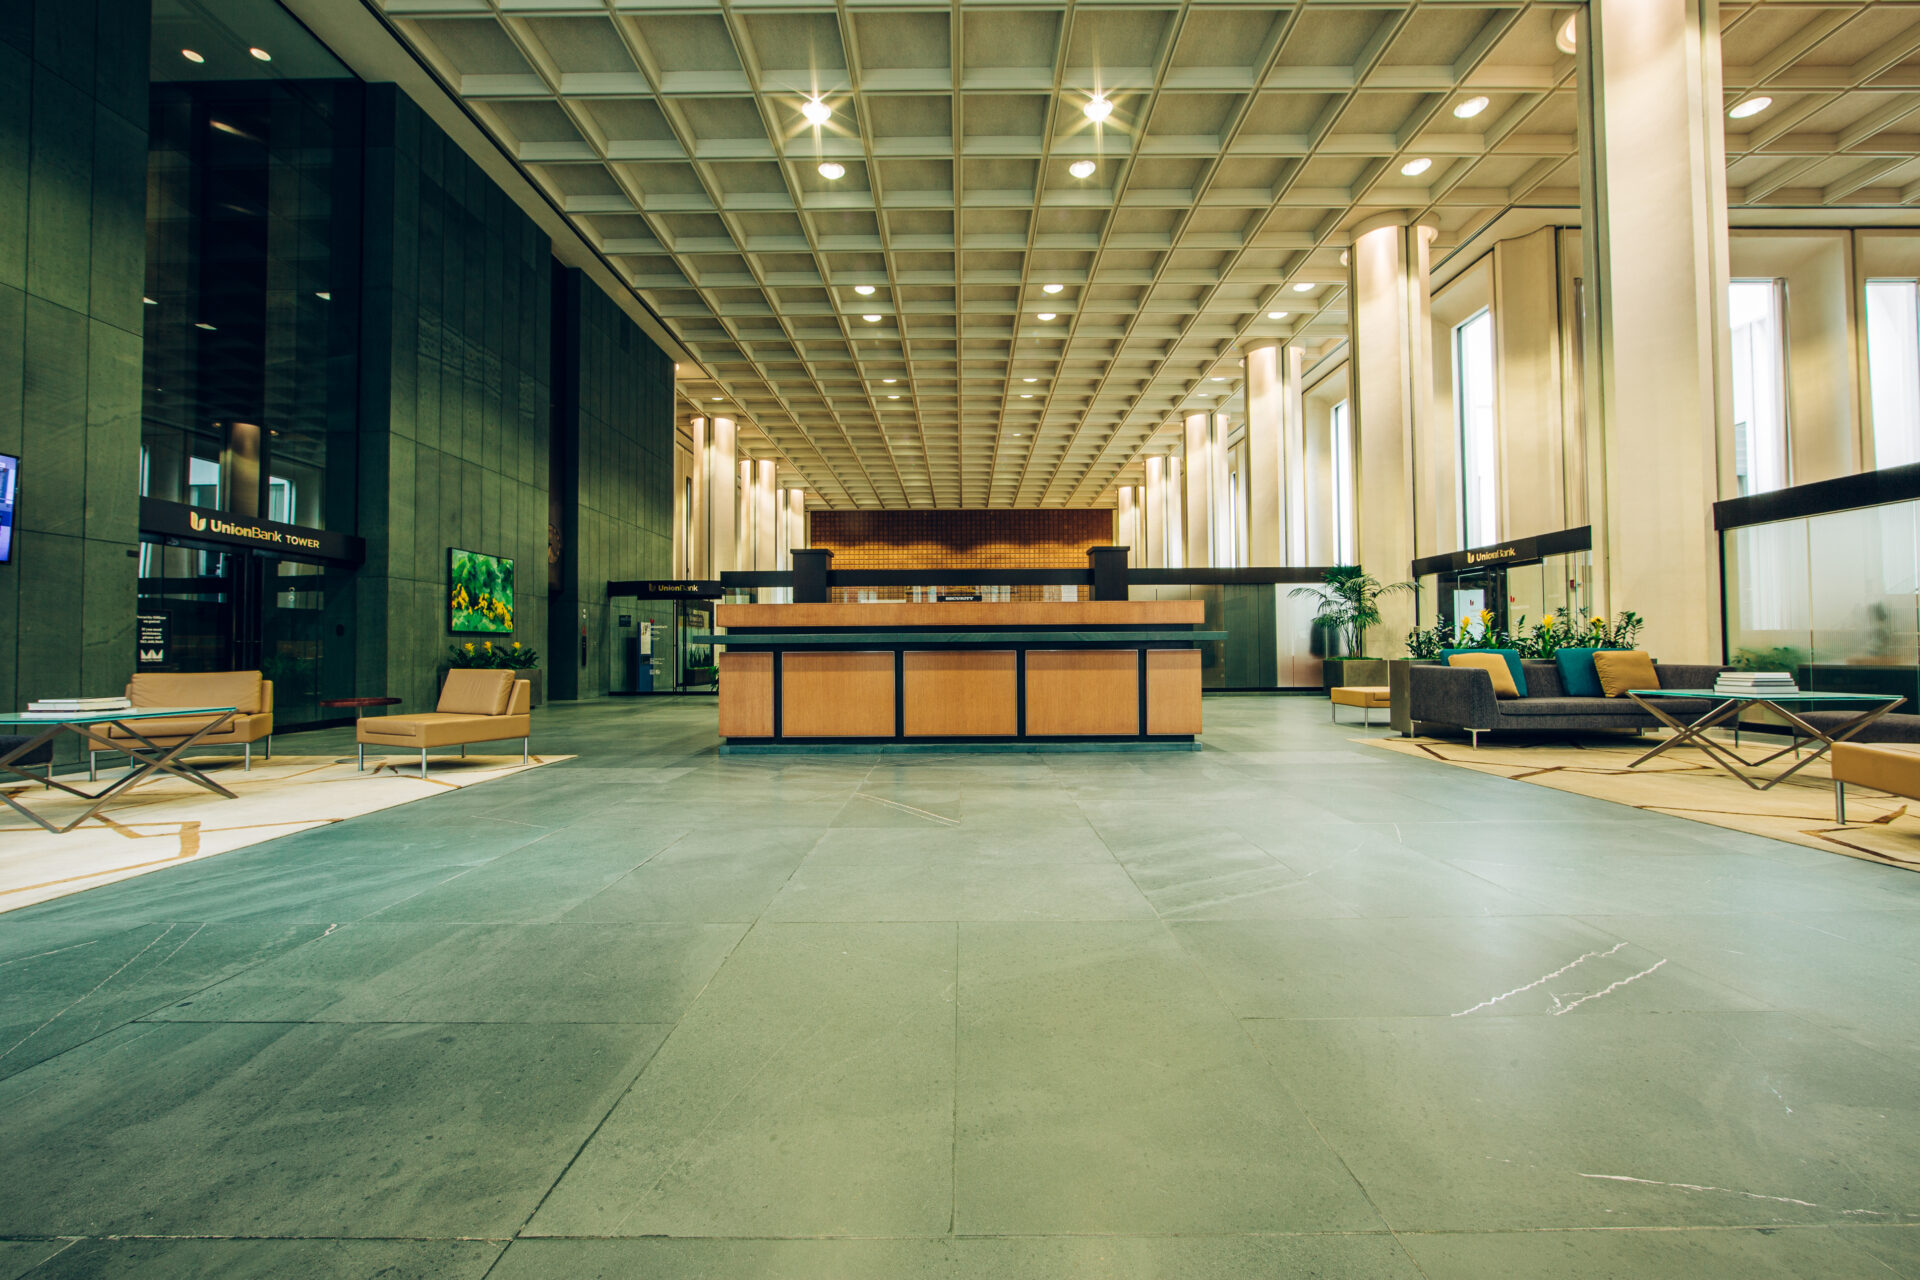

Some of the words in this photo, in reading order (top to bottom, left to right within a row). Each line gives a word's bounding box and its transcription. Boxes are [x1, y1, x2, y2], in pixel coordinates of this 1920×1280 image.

[210, 519, 282, 543] UnionBank
[285, 534, 320, 549] TOWER
[1475, 547, 1516, 562] UnionBank
